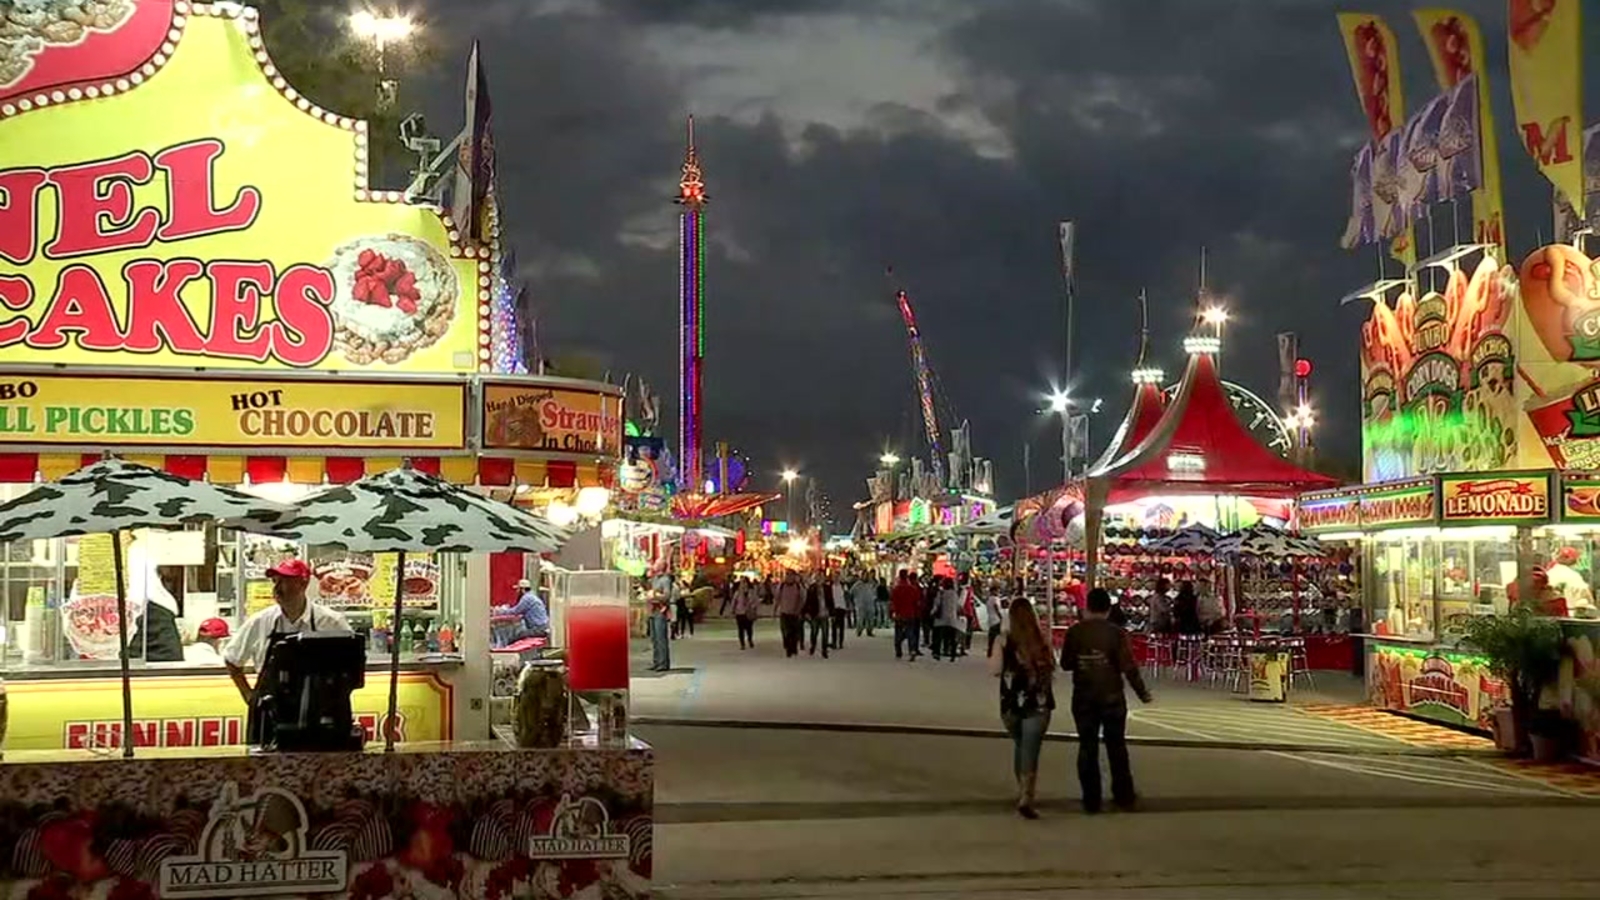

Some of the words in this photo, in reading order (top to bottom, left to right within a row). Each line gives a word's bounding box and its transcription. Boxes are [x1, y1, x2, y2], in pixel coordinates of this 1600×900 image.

[231, 390, 282, 410] HOT
[487, 398, 515, 412] Hand
[45, 406, 194, 435] PICKLES
[240, 409, 433, 438] CHOCOLATE
[1447, 493, 1545, 516] LEMONADE
[533, 839, 570, 851] MAD
[571, 839, 626, 851] HATTER
[170, 865, 232, 885] MAD
[240, 860, 337, 882] HATTER
